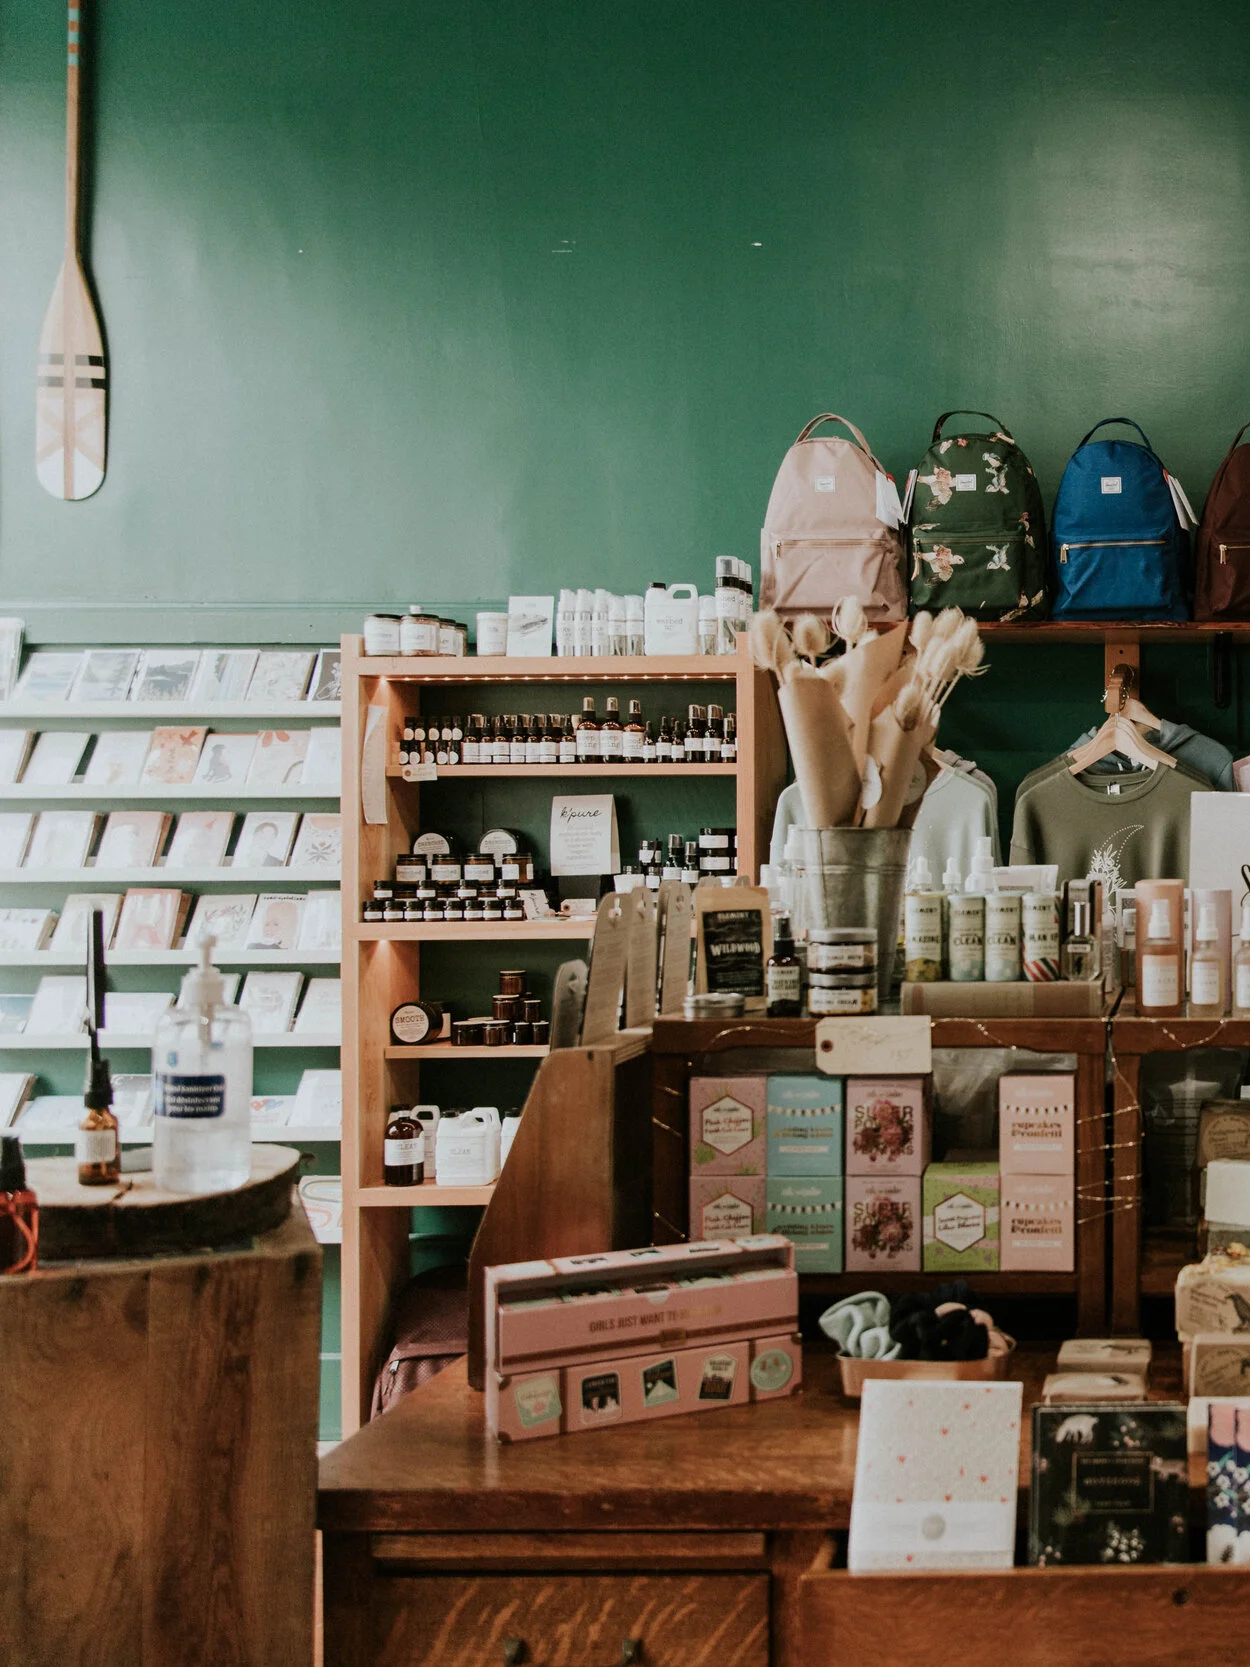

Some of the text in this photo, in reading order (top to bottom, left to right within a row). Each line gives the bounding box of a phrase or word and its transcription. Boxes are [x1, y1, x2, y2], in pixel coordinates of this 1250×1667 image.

[559, 806, 603, 824] k'pure
[953, 935, 983, 946] CLEAN
[986, 935, 1017, 946] CLEAN
[710, 941, 761, 957] WILDWOOD
[394, 1014, 425, 1024] SMOOTH
[855, 1105, 914, 1119] SUER
[589, 1319, 615, 1333] GIRLS
[617, 1315, 637, 1329] JUST
[640, 1312, 665, 1326] WANT
